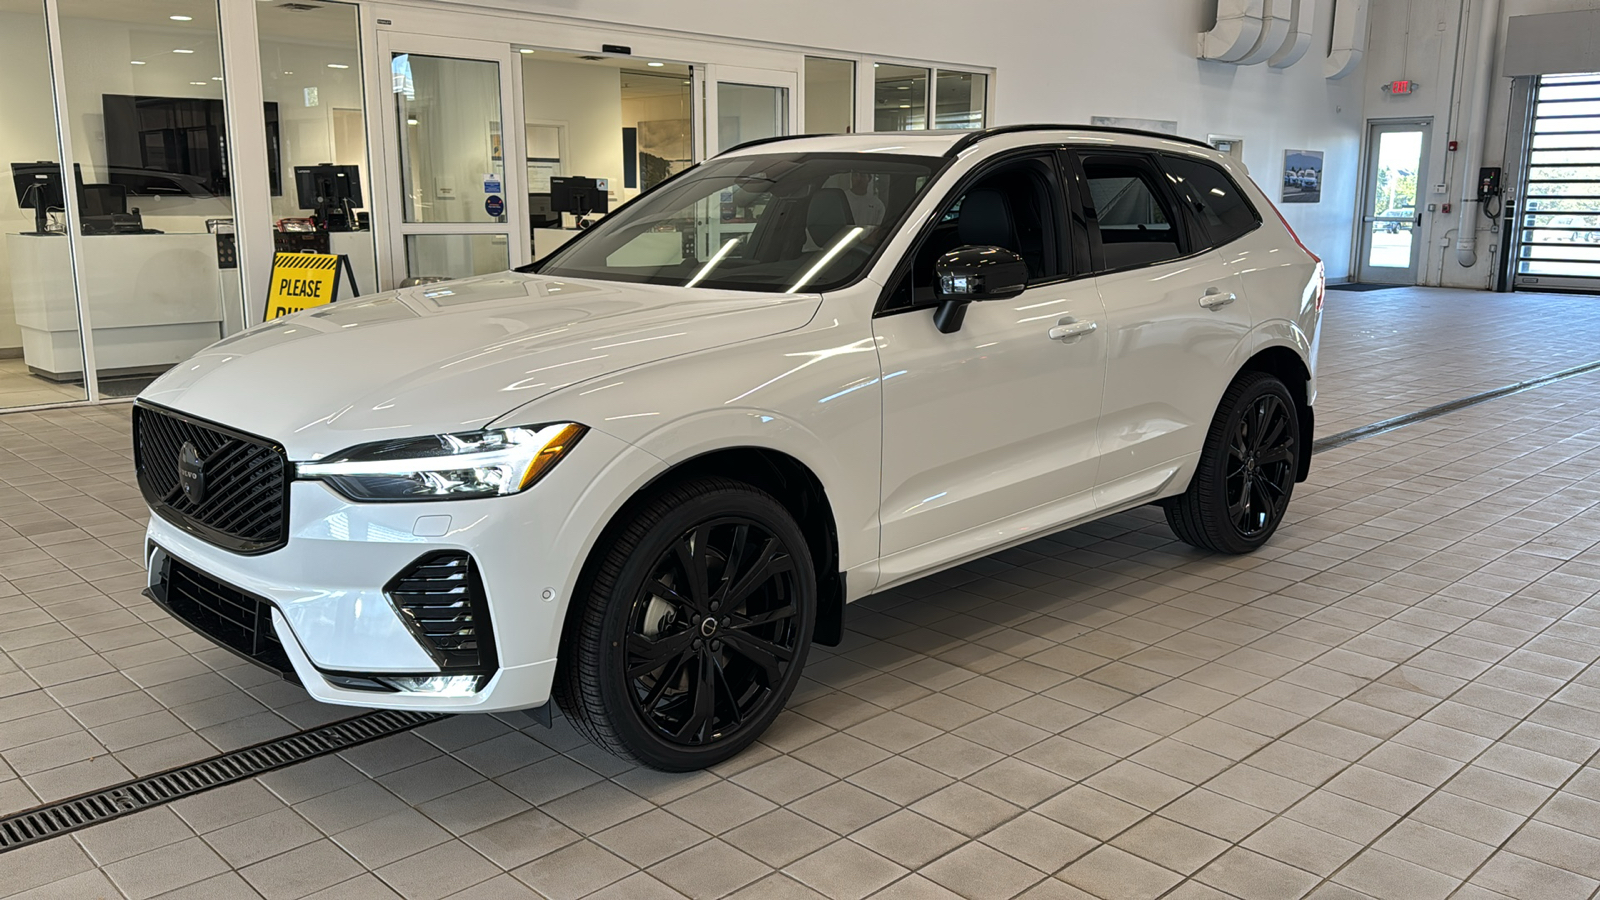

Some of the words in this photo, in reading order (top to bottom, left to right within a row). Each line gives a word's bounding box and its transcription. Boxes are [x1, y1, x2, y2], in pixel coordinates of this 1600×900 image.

[1392, 81, 1408, 93] EXIT
[279, 278, 322, 298] PLEASE
[181, 469, 197, 480] OLVO
